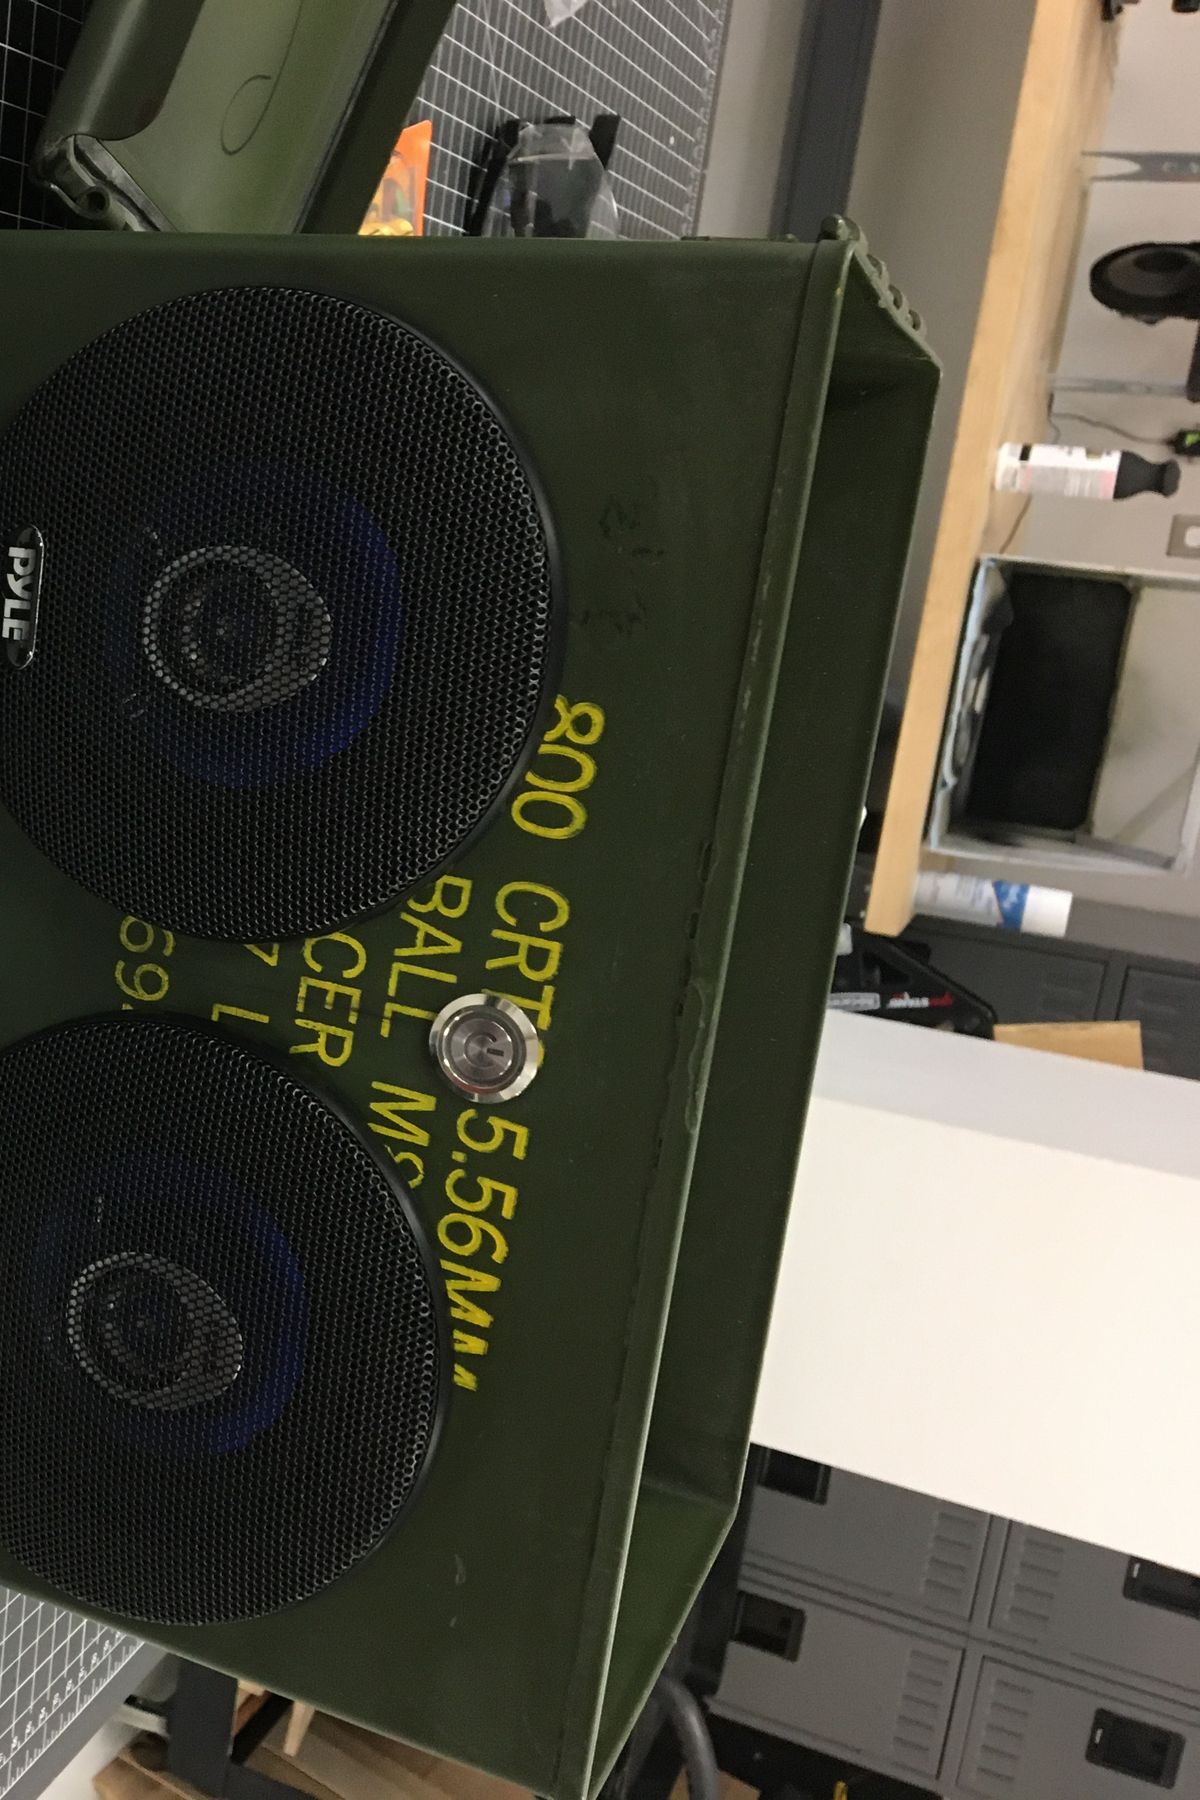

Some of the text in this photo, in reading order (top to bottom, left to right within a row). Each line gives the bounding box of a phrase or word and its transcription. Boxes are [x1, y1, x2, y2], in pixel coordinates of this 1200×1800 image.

[2, 546, 36, 641] PYLE
[511, 694, 605, 839] 800
[290, 931, 366, 1067] CER
[380, 874, 472, 1038] BALL
[480, 881, 570, 1068] CRT
